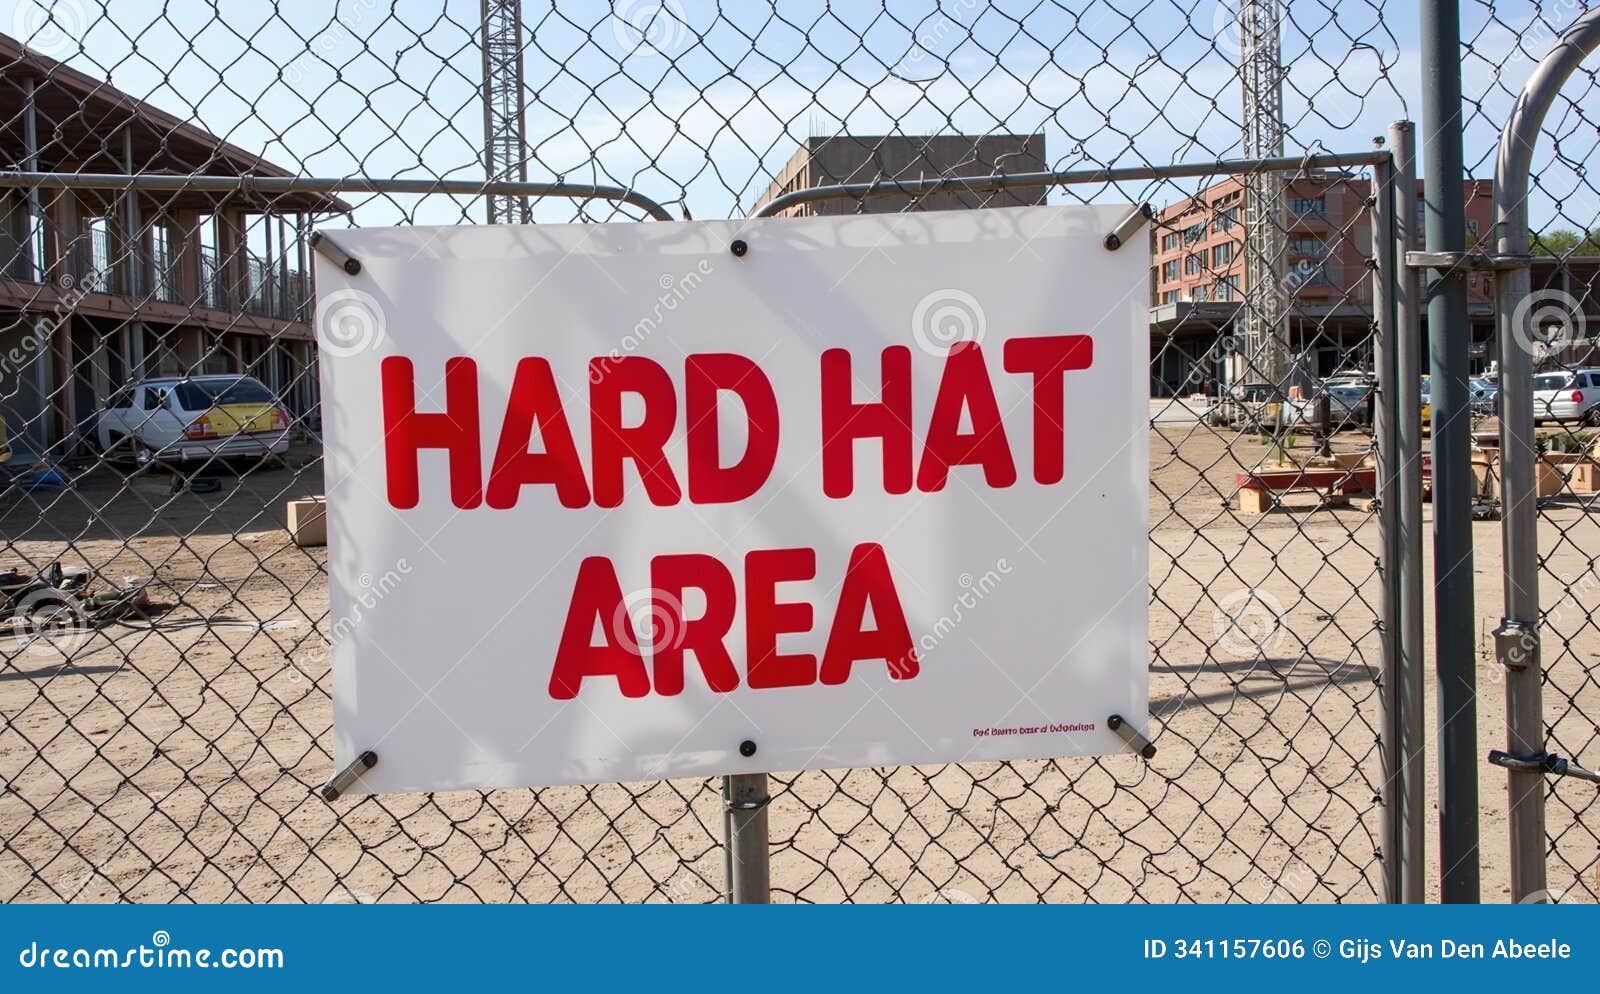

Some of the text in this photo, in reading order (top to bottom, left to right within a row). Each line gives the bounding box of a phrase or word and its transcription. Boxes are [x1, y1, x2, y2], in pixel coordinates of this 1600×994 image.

[381, 335, 1092, 509] HARD HAT
[549, 542, 919, 699] AREA
